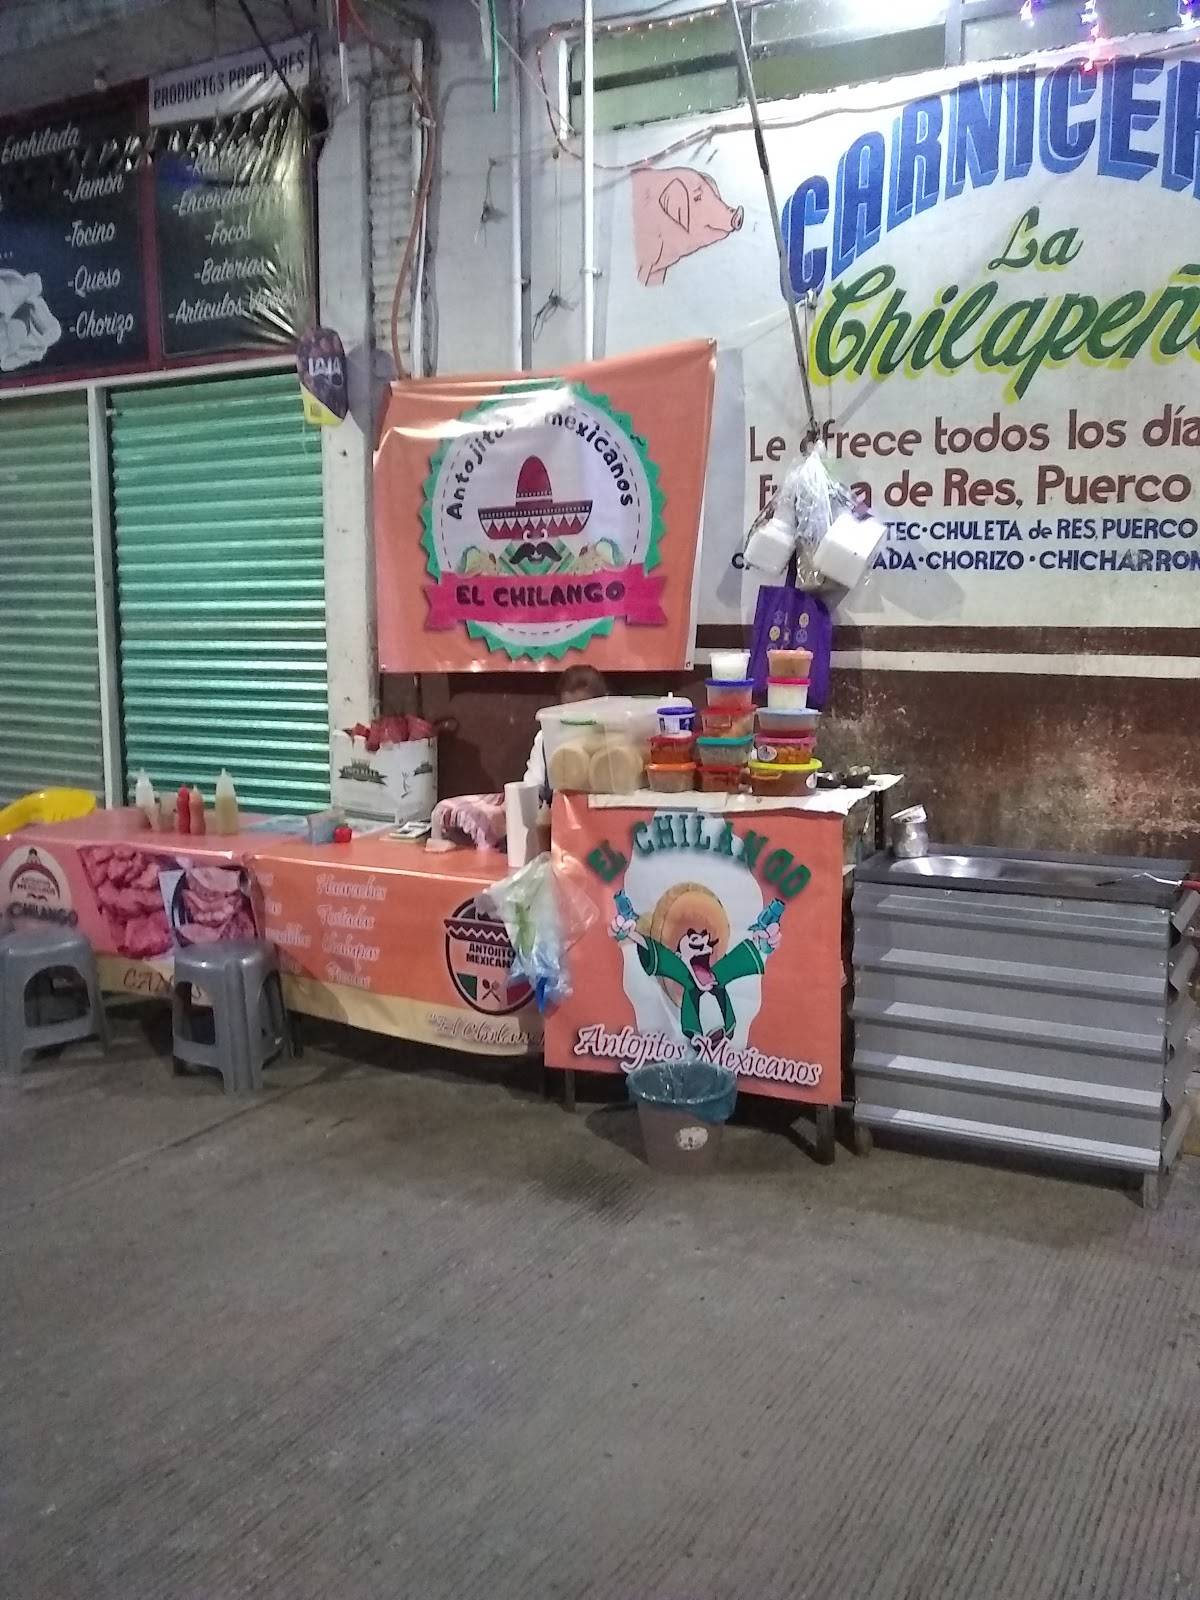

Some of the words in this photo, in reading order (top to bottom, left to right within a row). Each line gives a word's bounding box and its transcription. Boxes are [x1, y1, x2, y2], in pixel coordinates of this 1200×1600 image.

[153, 71, 225, 111] PRODUCTOS
[988, 207, 1083, 271] La
[749, 426, 786, 462] Le
[935, 412, 1050, 455] todos
[1068, 409, 1127, 450] los
[884, 469, 933, 507] de
[943, 467, 1023, 510] Res,
[1036, 464, 1192, 505] Puerco
[1028, 519, 1053, 540] de
[1102, 518, 1198, 540] PUERCO
[456, 585, 485, 606] EL
[492, 580, 626, 608] CHILANGO
[587, 840, 628, 883] EL
[631, 813, 813, 899] CHILANGO
[465, 952, 512, 969] MEXICAN
[469, 943, 516, 958] ANTOJITO
[573, 1024, 688, 1073] Antojitos
[690, 1035, 824, 1086] Mexicanos
